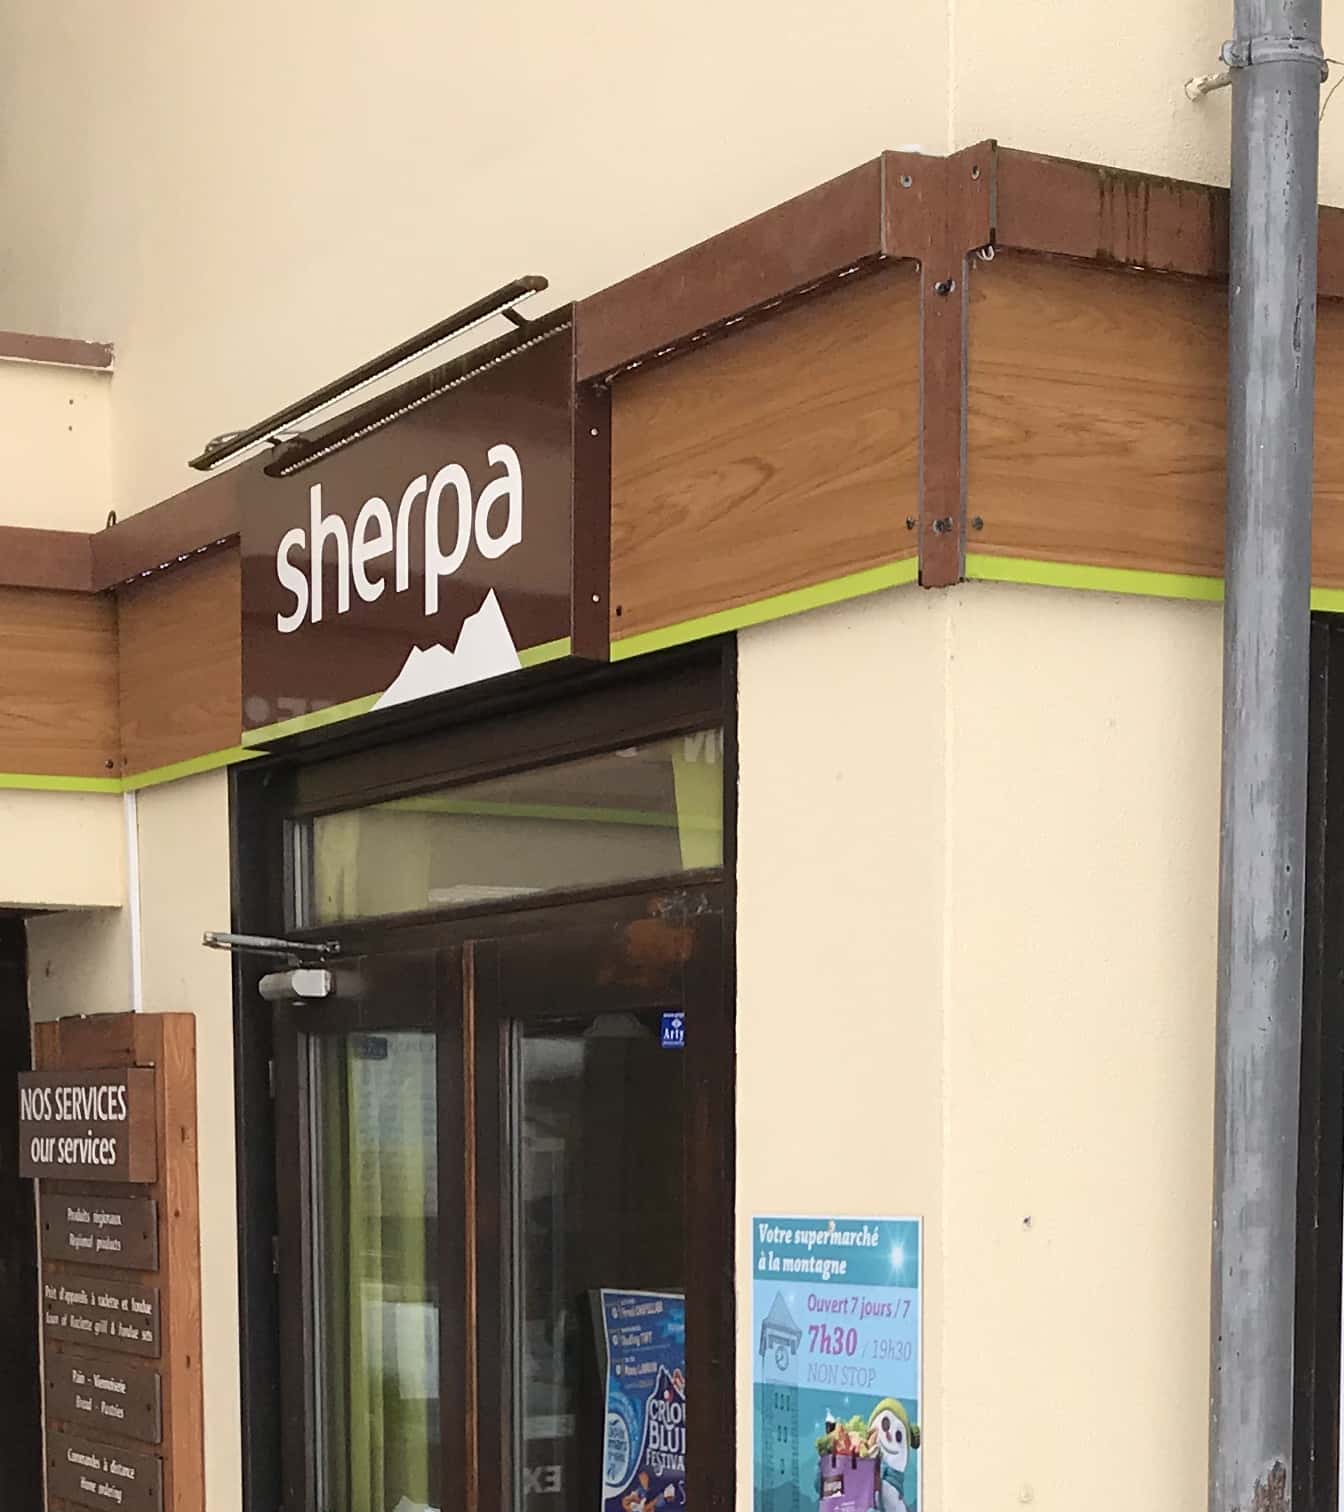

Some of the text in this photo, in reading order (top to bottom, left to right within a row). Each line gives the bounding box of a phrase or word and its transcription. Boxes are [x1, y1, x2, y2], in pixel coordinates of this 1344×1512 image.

[276, 443, 523, 633] sherpa
[20, 1085, 127, 1121] NOS SERVICES
[31, 1129, 117, 1165] our services
[758, 1223, 880, 1251] Votre supermarché
[758, 1251, 847, 1280] à la montagne
[807, 1293, 849, 1315] Ouvert
[851, 1297, 859, 1315] 7
[859, 1297, 892, 1321] jours
[903, 1300, 911, 1319] 7
[807, 1323, 858, 1357] 7h30
[871, 1337, 912, 1361] 19h30
[807, 1361, 877, 1389] NON STOP
